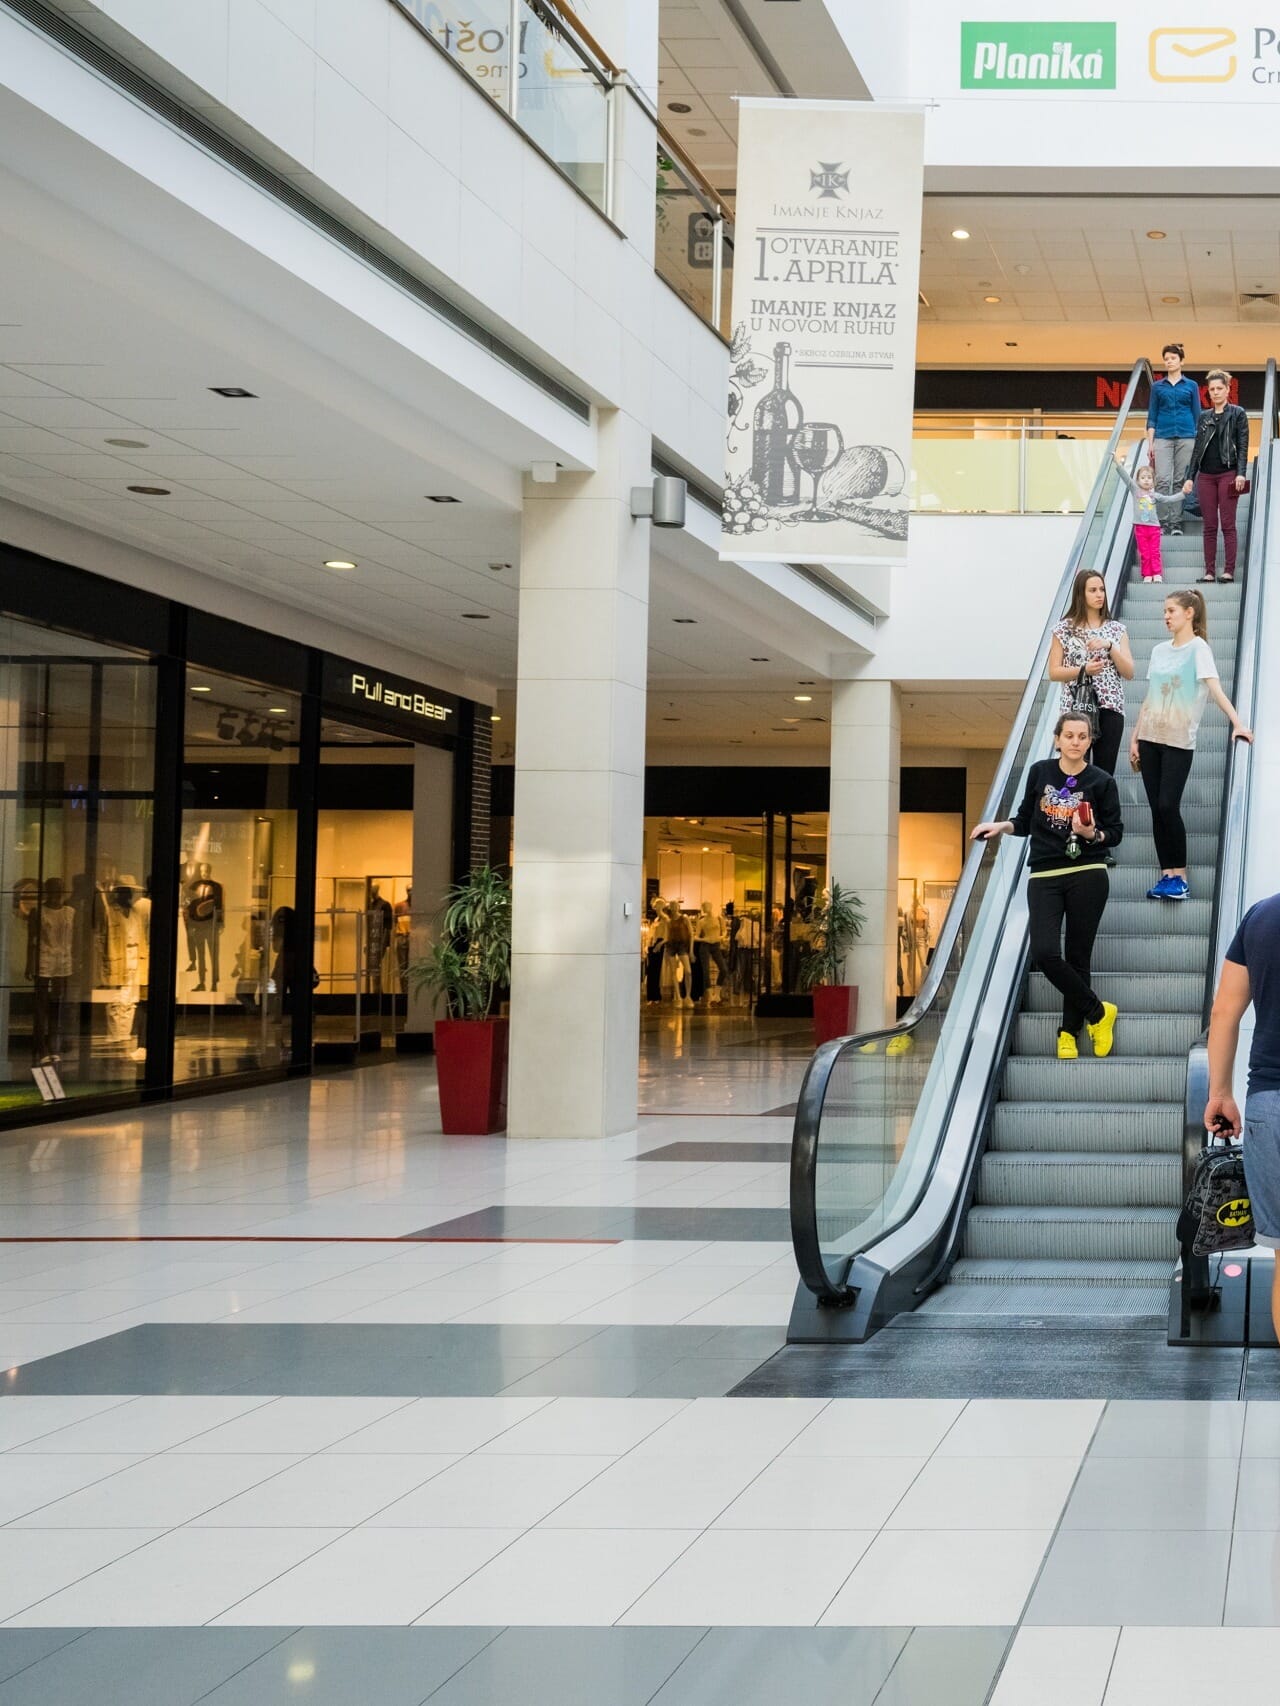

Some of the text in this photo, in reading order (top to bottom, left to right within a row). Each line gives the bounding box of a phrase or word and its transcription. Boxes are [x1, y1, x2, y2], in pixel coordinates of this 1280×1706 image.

[974, 41, 1103, 79] Planika
[754, 237, 780, 282] 1.
[770, 237, 898, 259] OTVARANJE
[750, 299, 897, 319] IMANJE KNJAZ
[750, 317, 896, 335] U NOVOM RUHU
[352, 674, 453, 720] Pull and Bear
